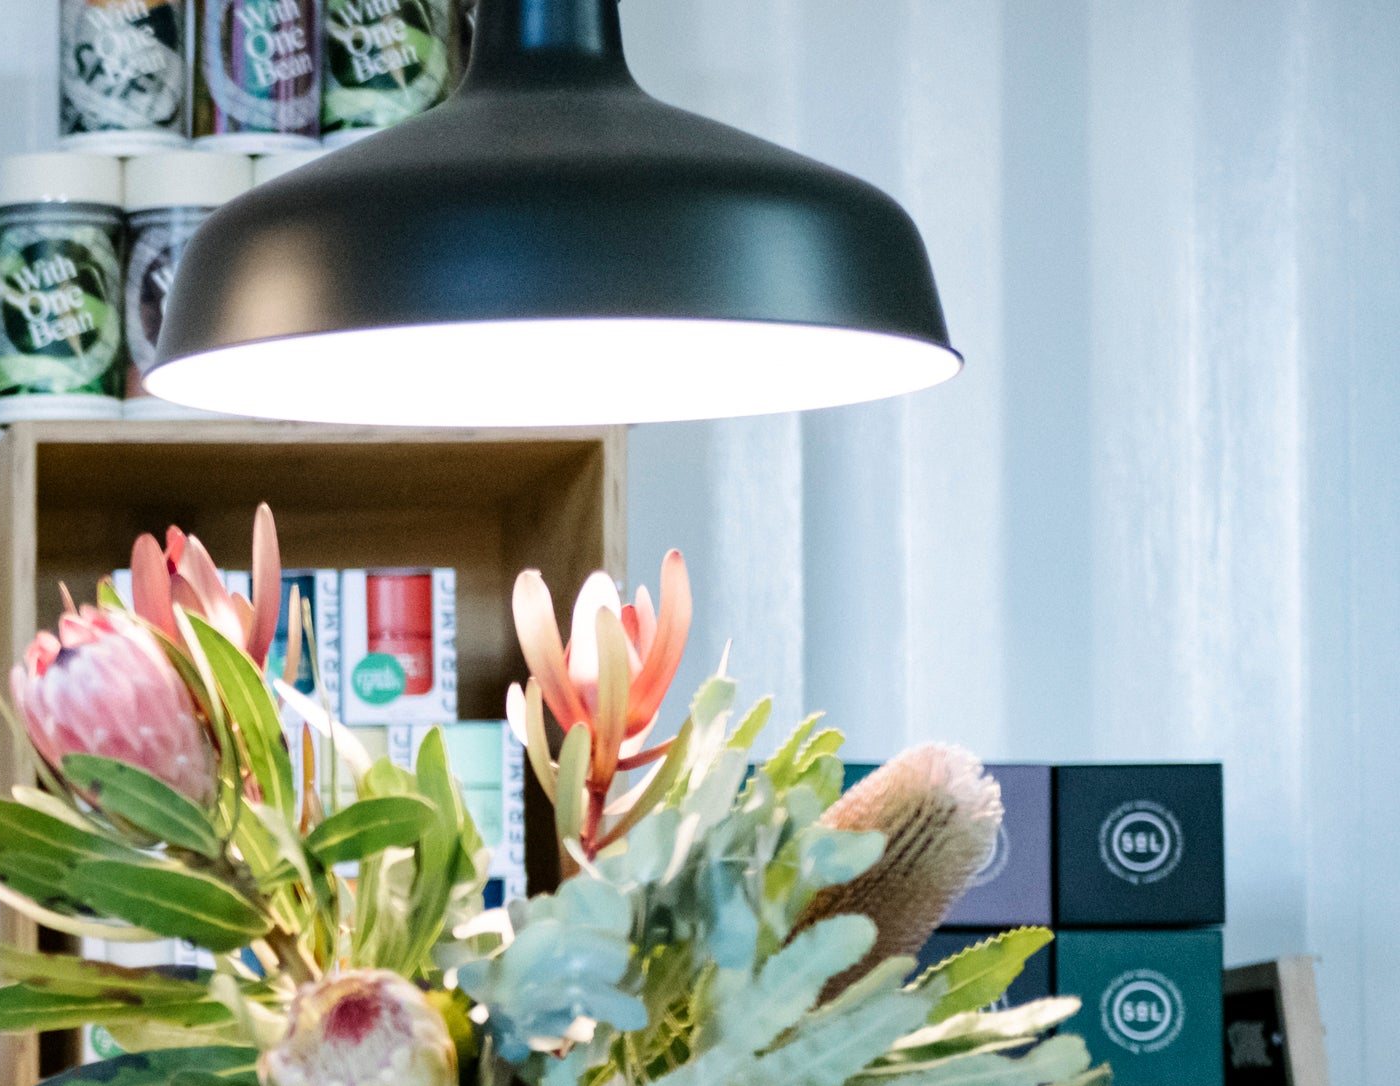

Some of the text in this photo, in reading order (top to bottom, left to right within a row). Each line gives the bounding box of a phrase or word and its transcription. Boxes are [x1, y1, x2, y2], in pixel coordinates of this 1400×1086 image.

[246, 27, 306, 60] One
[350, 17, 407, 57] One
[254, 51, 313, 86] Bean
[352, 44, 419, 83] Bean
[13, 254, 78, 291] With
[22, 285, 85, 320] One
[29, 311, 95, 349] Bean
[1122, 1000, 1162, 1022] SOL
